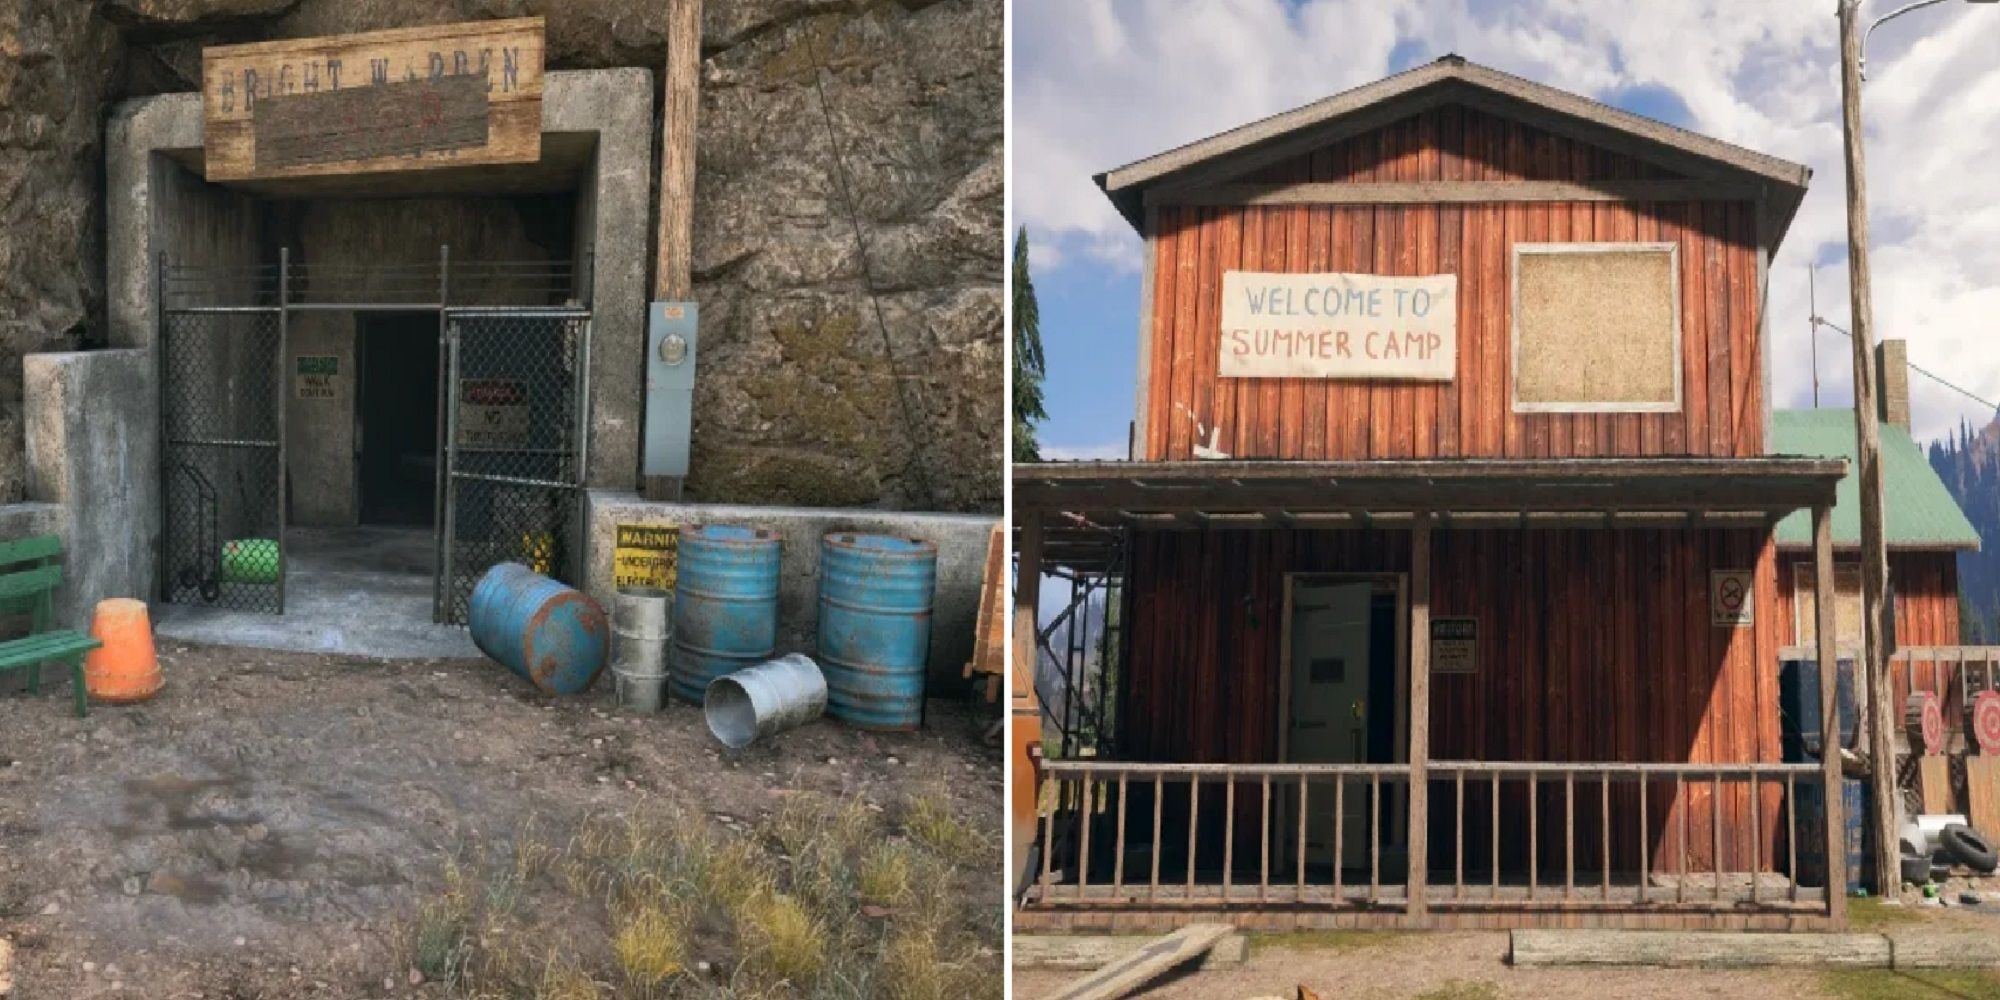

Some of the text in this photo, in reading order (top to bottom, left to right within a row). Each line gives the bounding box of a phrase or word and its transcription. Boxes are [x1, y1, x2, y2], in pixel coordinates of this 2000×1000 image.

[221, 59, 343, 113] BRIGHT
[1245, 286, 1431, 317] WELCOME TO
[1231, 328, 1442, 360] SUMMER CAMP
[622, 532, 678, 547] WARNIN
